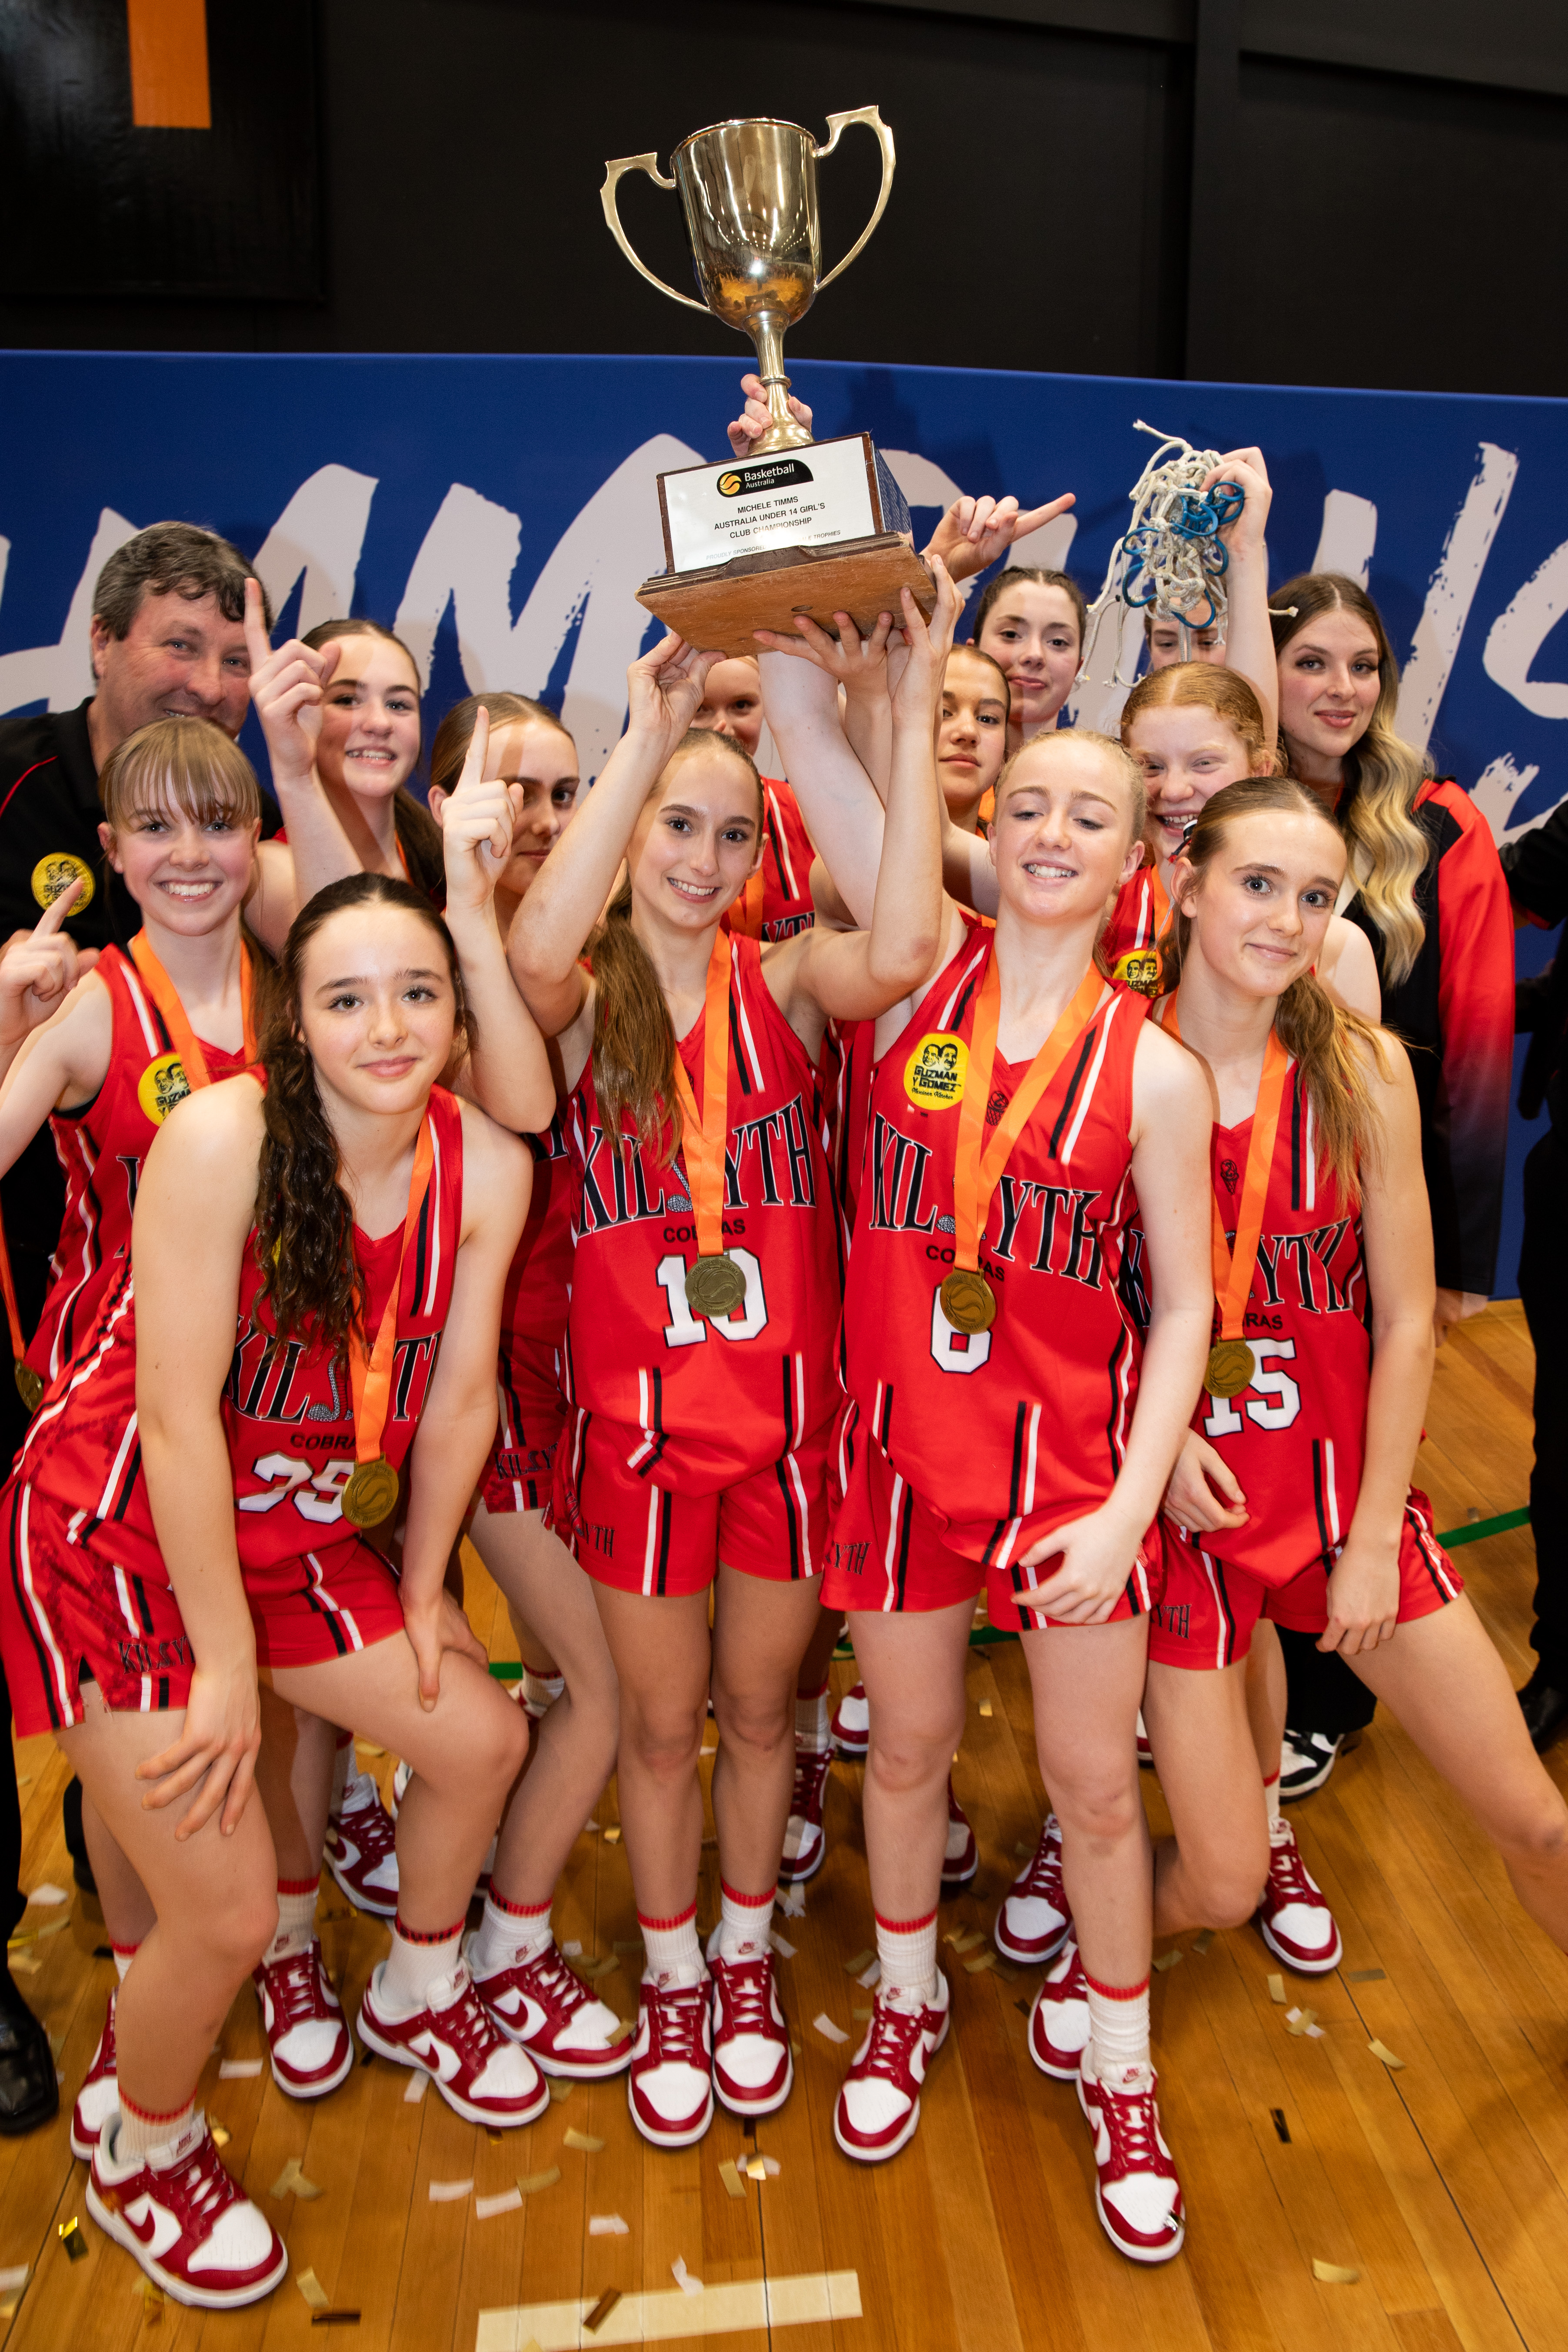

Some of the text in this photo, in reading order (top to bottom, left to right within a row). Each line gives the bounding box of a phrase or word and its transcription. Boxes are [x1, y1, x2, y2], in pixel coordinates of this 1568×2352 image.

[744, 463, 795, 482] Basketball
[746, 478, 775, 489] Australia
[737, 496, 798, 514] MICHELE TIMMS
[714, 517, 757, 530] AUSTRALIA
[759, 510, 787, 521] UNDER
[800, 503, 825, 513] GIRL'S
[730, 517, 812, 538] CLUB CHAMPIONSHIP
[706, 551, 732, 560] PROUDLY
[733, 545, 766, 555] SPONSORED
[814, 530, 841, 540] TROPHIES
[914, 1065, 958, 1082] GUZMAN
[913, 1077, 957, 1092] Y GOMEZ
[155, 1088, 191, 1107] GUZM
[912, 1088, 954, 1101] Mexican Kitchen
[655, 1246, 769, 1349] 10
